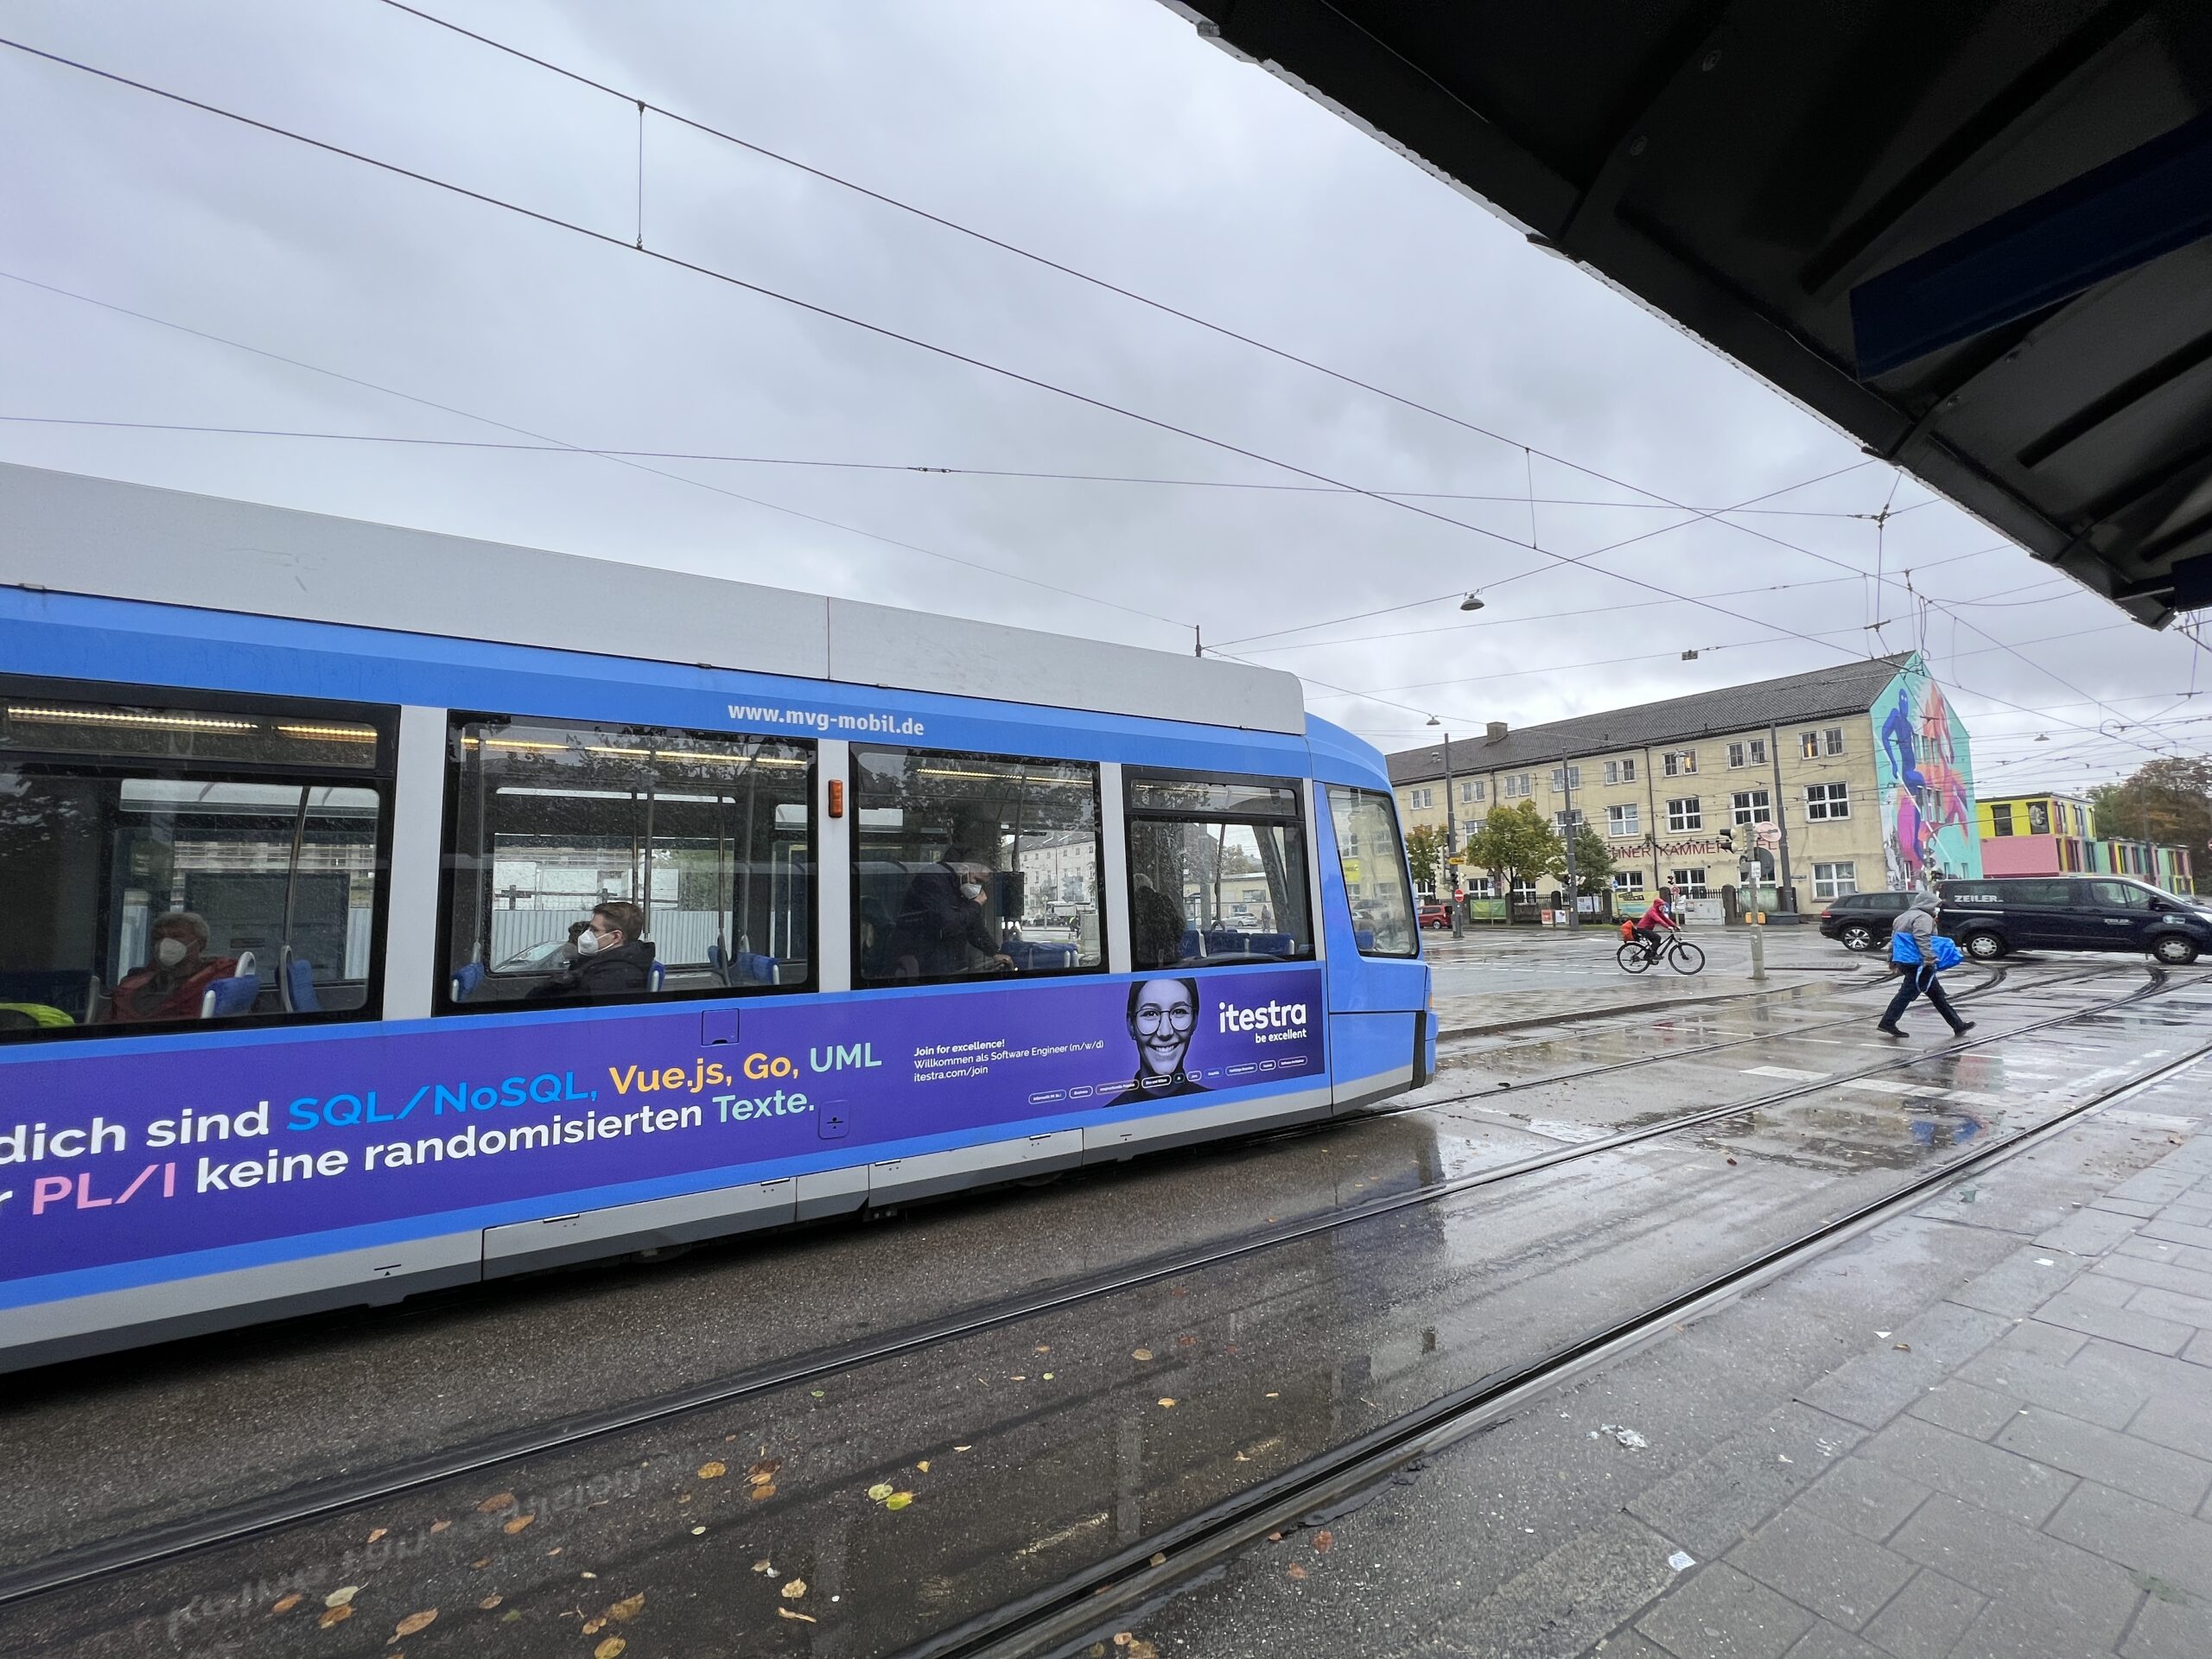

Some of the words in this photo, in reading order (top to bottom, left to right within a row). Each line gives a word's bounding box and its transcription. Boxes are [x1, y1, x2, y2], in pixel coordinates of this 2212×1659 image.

[728, 704, 925, 735] www.mvg-mobil.de
[1219, 1000, 1306, 1033] itestra
[914, 1046, 934, 1056] Join
[937, 1045, 950, 1053] for
[952, 1039, 1005, 1052] excellence!
[1255, 1033, 1267, 1044] be
[1268, 1028, 1307, 1042] excellent
[914, 1056, 973, 1069] Willkommen
[976, 1053, 988, 1063] als
[991, 1050, 1029, 1060] Software
[1032, 1046, 1068, 1057] Engineer
[1070, 1039, 1104, 1052] (m/w/d)
[914, 1065, 988, 1082] itestra.com/join
[0, 1117, 125, 1165] dich
[146, 1101, 269, 1148] sind
[287, 1071, 597, 1131] SQL/NoSQL,
[609, 1058, 733, 1095] Vue.js,
[743, 1052, 799, 1080] Go,
[810, 1043, 881, 1073] UML
[197, 1150, 348, 1193] keine
[365, 1103, 702, 1171] randomisierten
[713, 1090, 814, 1123] Texte.
